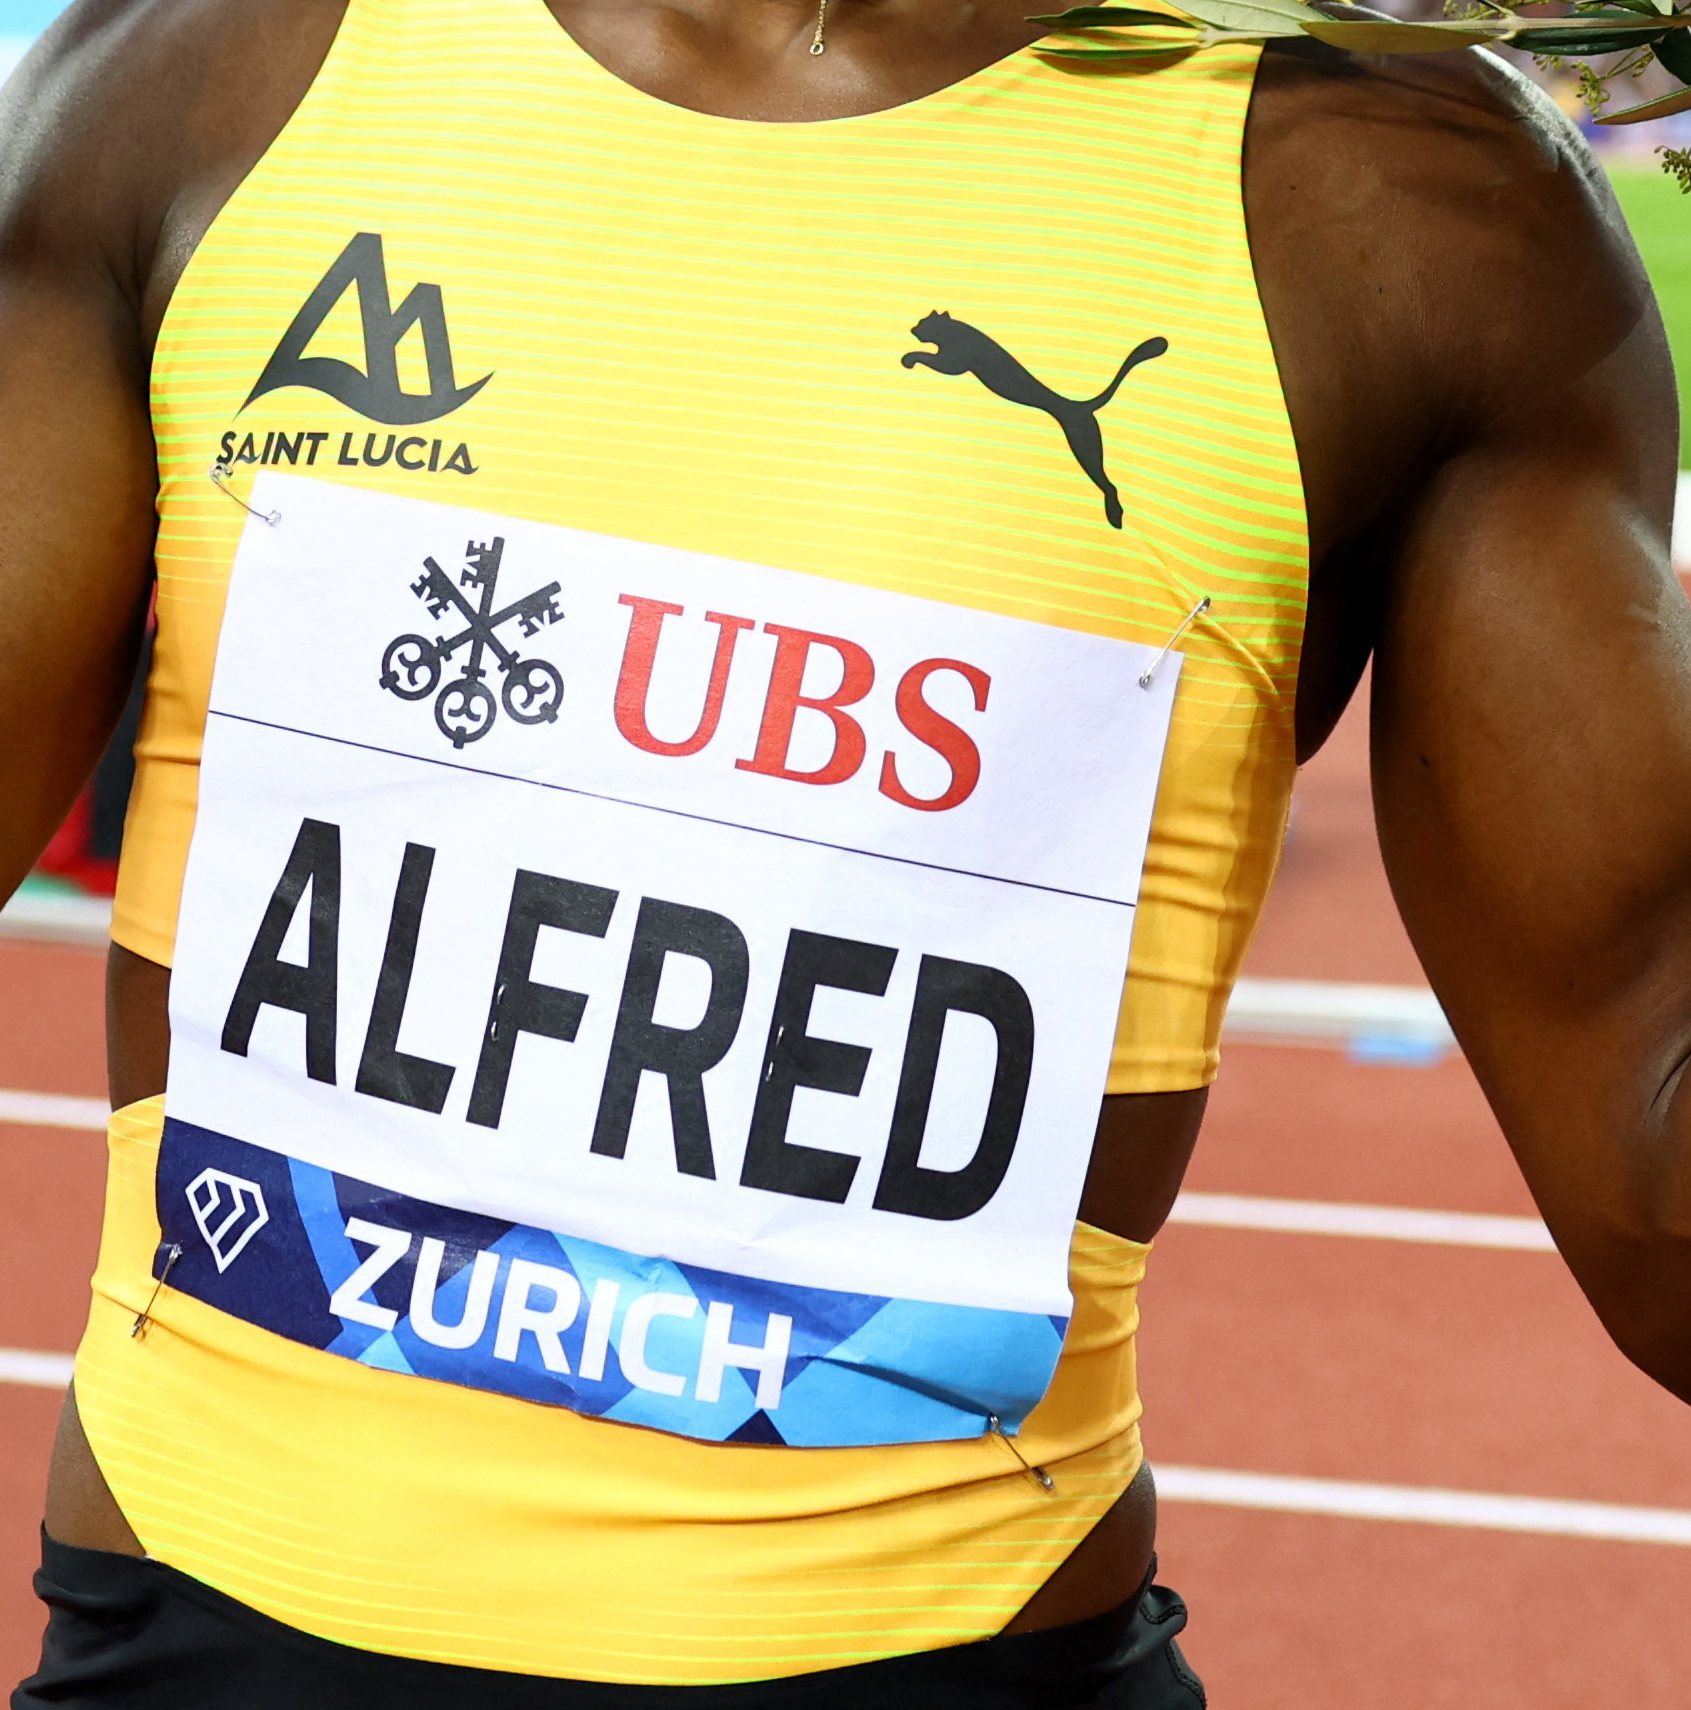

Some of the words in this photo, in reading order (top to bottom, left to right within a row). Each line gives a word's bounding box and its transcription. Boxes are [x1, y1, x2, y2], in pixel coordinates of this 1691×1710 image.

[216, 430, 329, 466] SAINT
[337, 431, 480, 475] LUCIA
[612, 594, 991, 811] UBS
[220, 817, 1035, 1221] ALFRED
[329, 1216, 793, 1410] ZURICH
